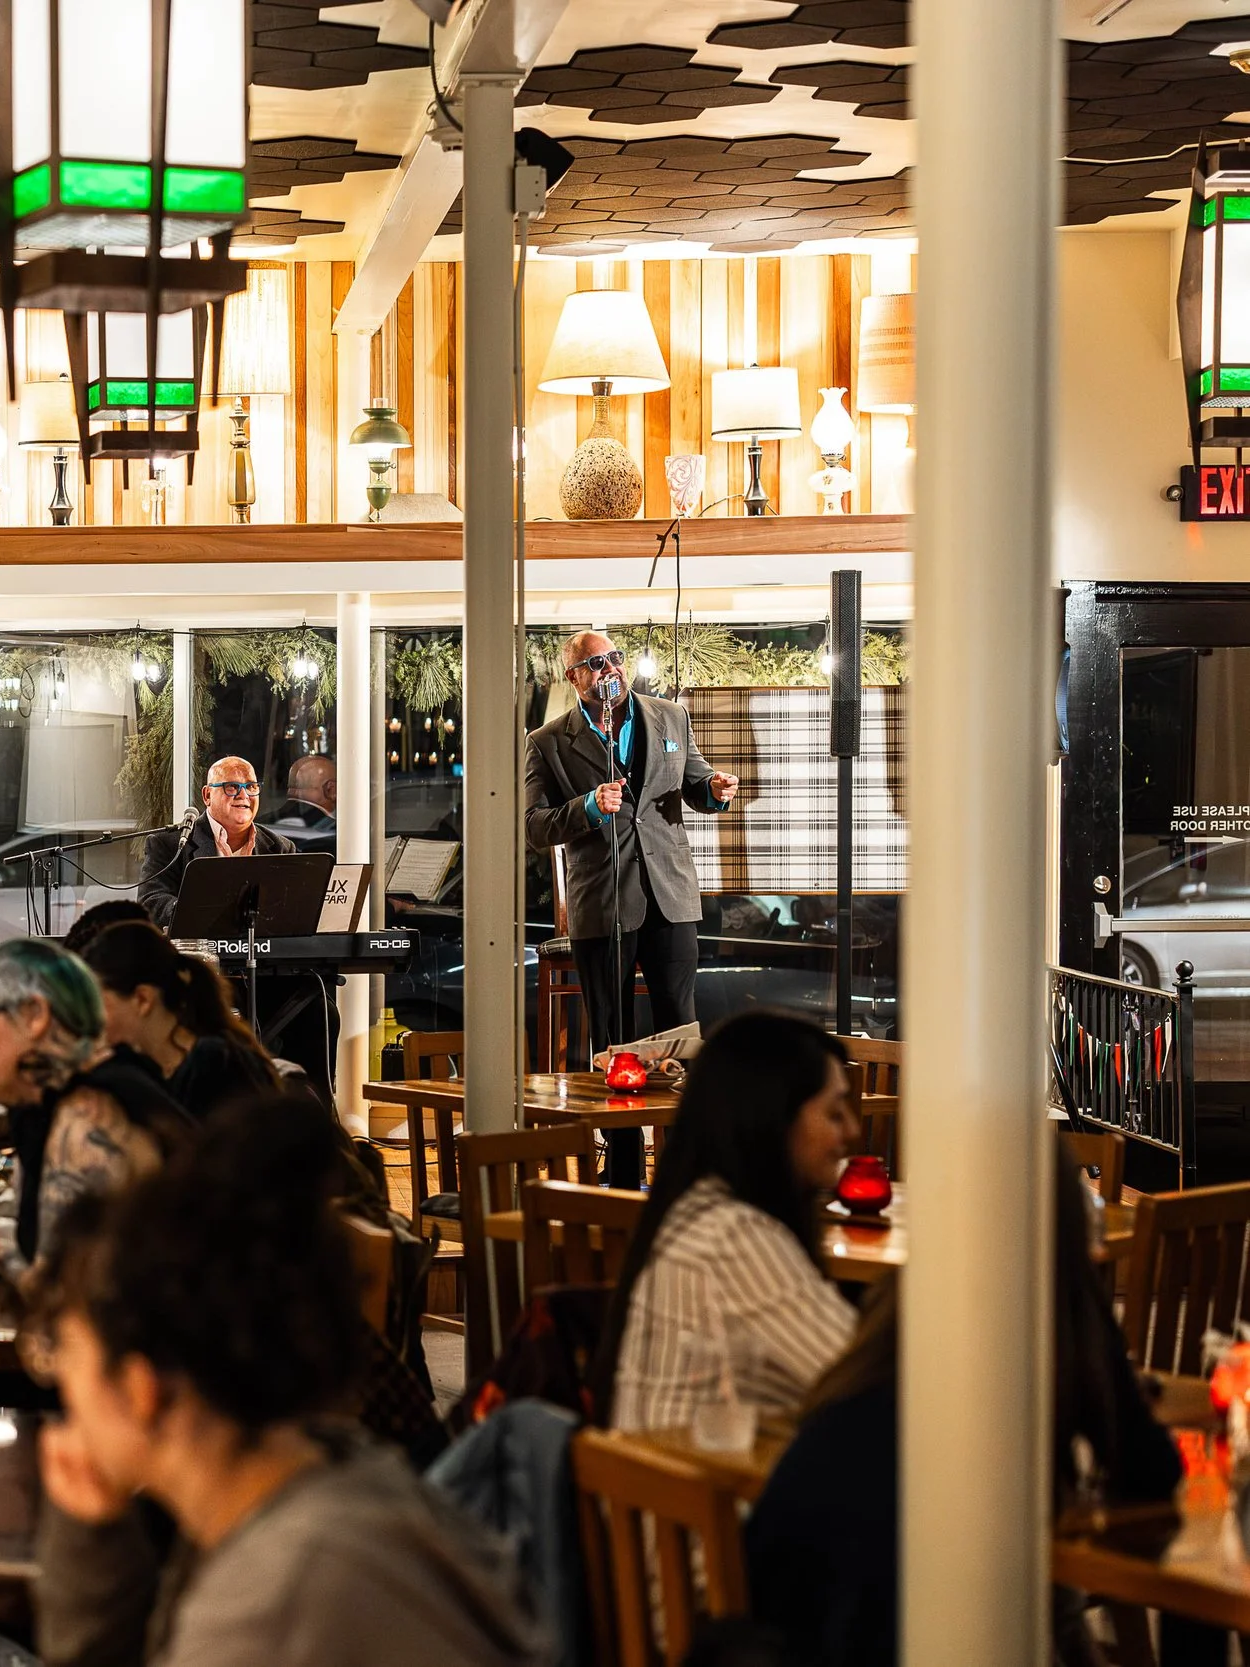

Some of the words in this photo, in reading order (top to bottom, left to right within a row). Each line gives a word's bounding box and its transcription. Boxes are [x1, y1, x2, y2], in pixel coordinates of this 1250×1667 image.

[1200, 467, 1250, 514] EXI
[217, 939, 271, 954] Roland
[369, 939, 411, 949] RD-08
